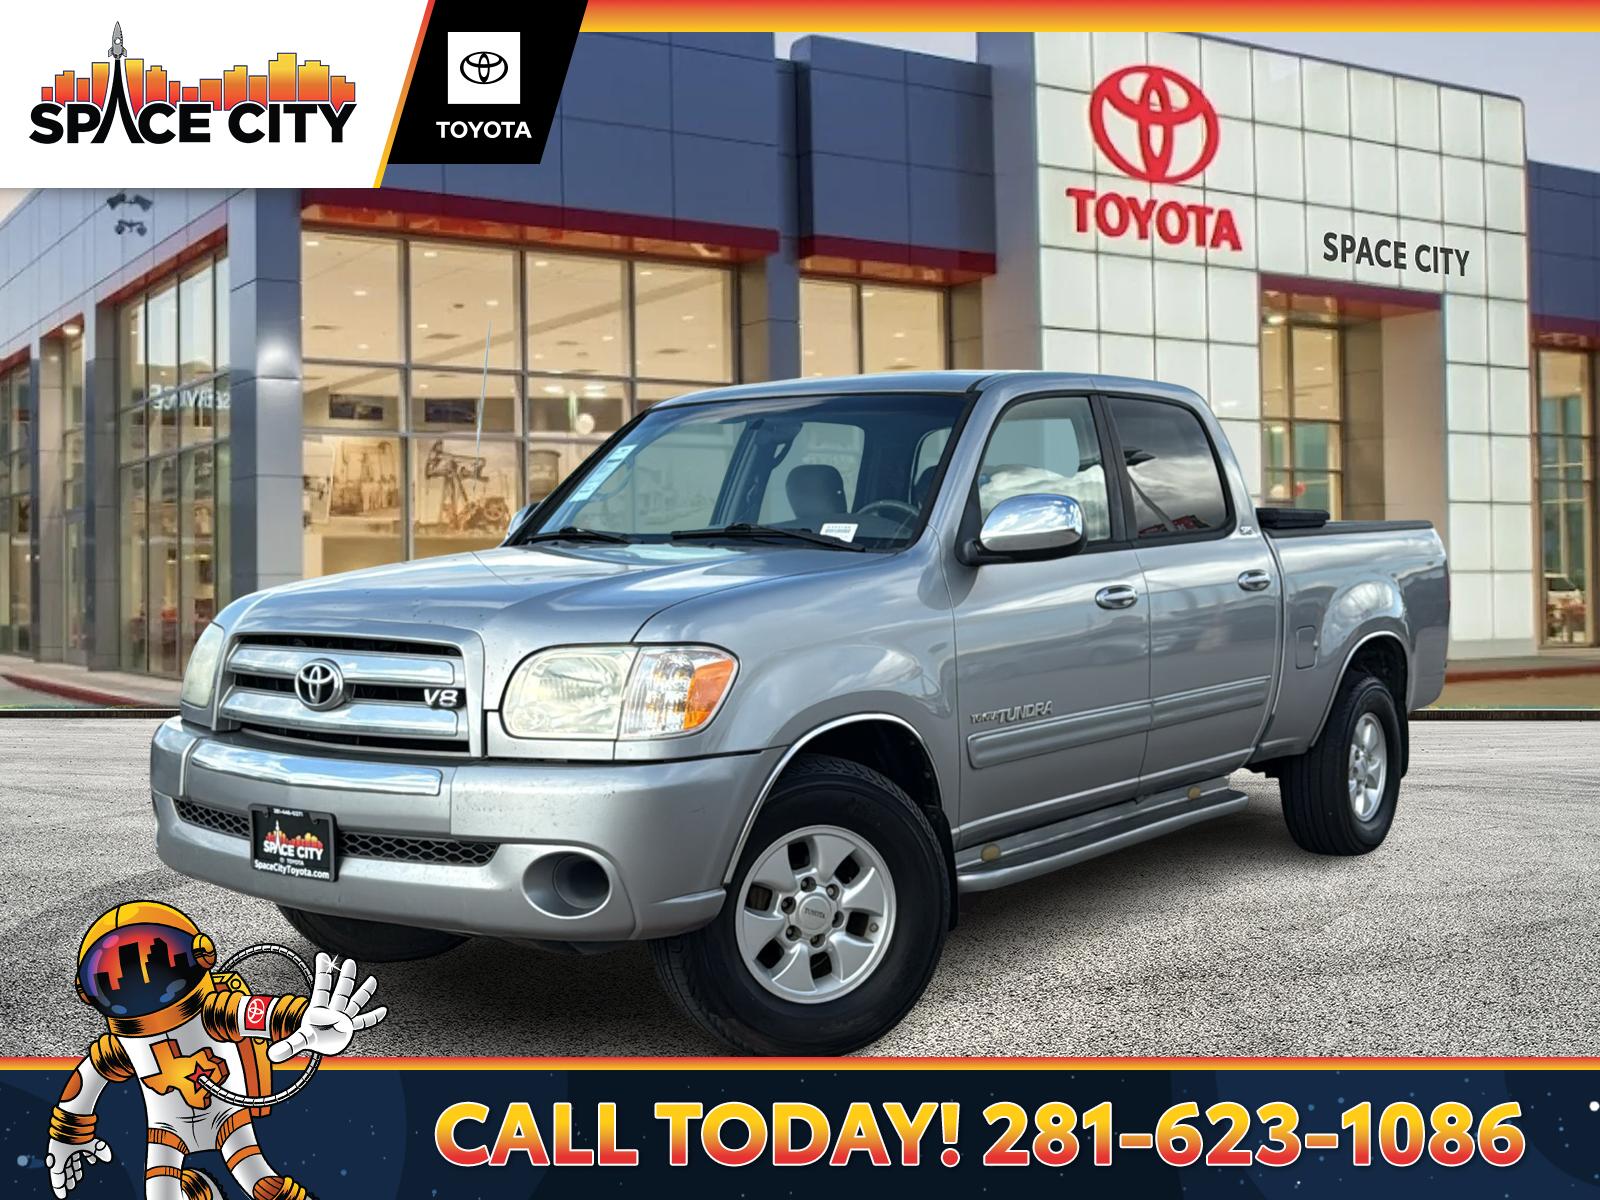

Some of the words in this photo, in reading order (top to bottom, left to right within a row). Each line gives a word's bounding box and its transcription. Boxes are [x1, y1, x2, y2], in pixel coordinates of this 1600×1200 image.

[1066, 187, 1242, 251] TOYOTA
[1323, 232, 1407, 270] SPACE
[1415, 244, 1471, 277] CITY
[424, 688, 458, 707] V8
[998, 700, 1053, 724] TUNDRA
[263, 838, 295, 857] SPACE
[296, 845, 325, 860] CITY
[254, 859, 330, 879] SpaceCityToyota.com
